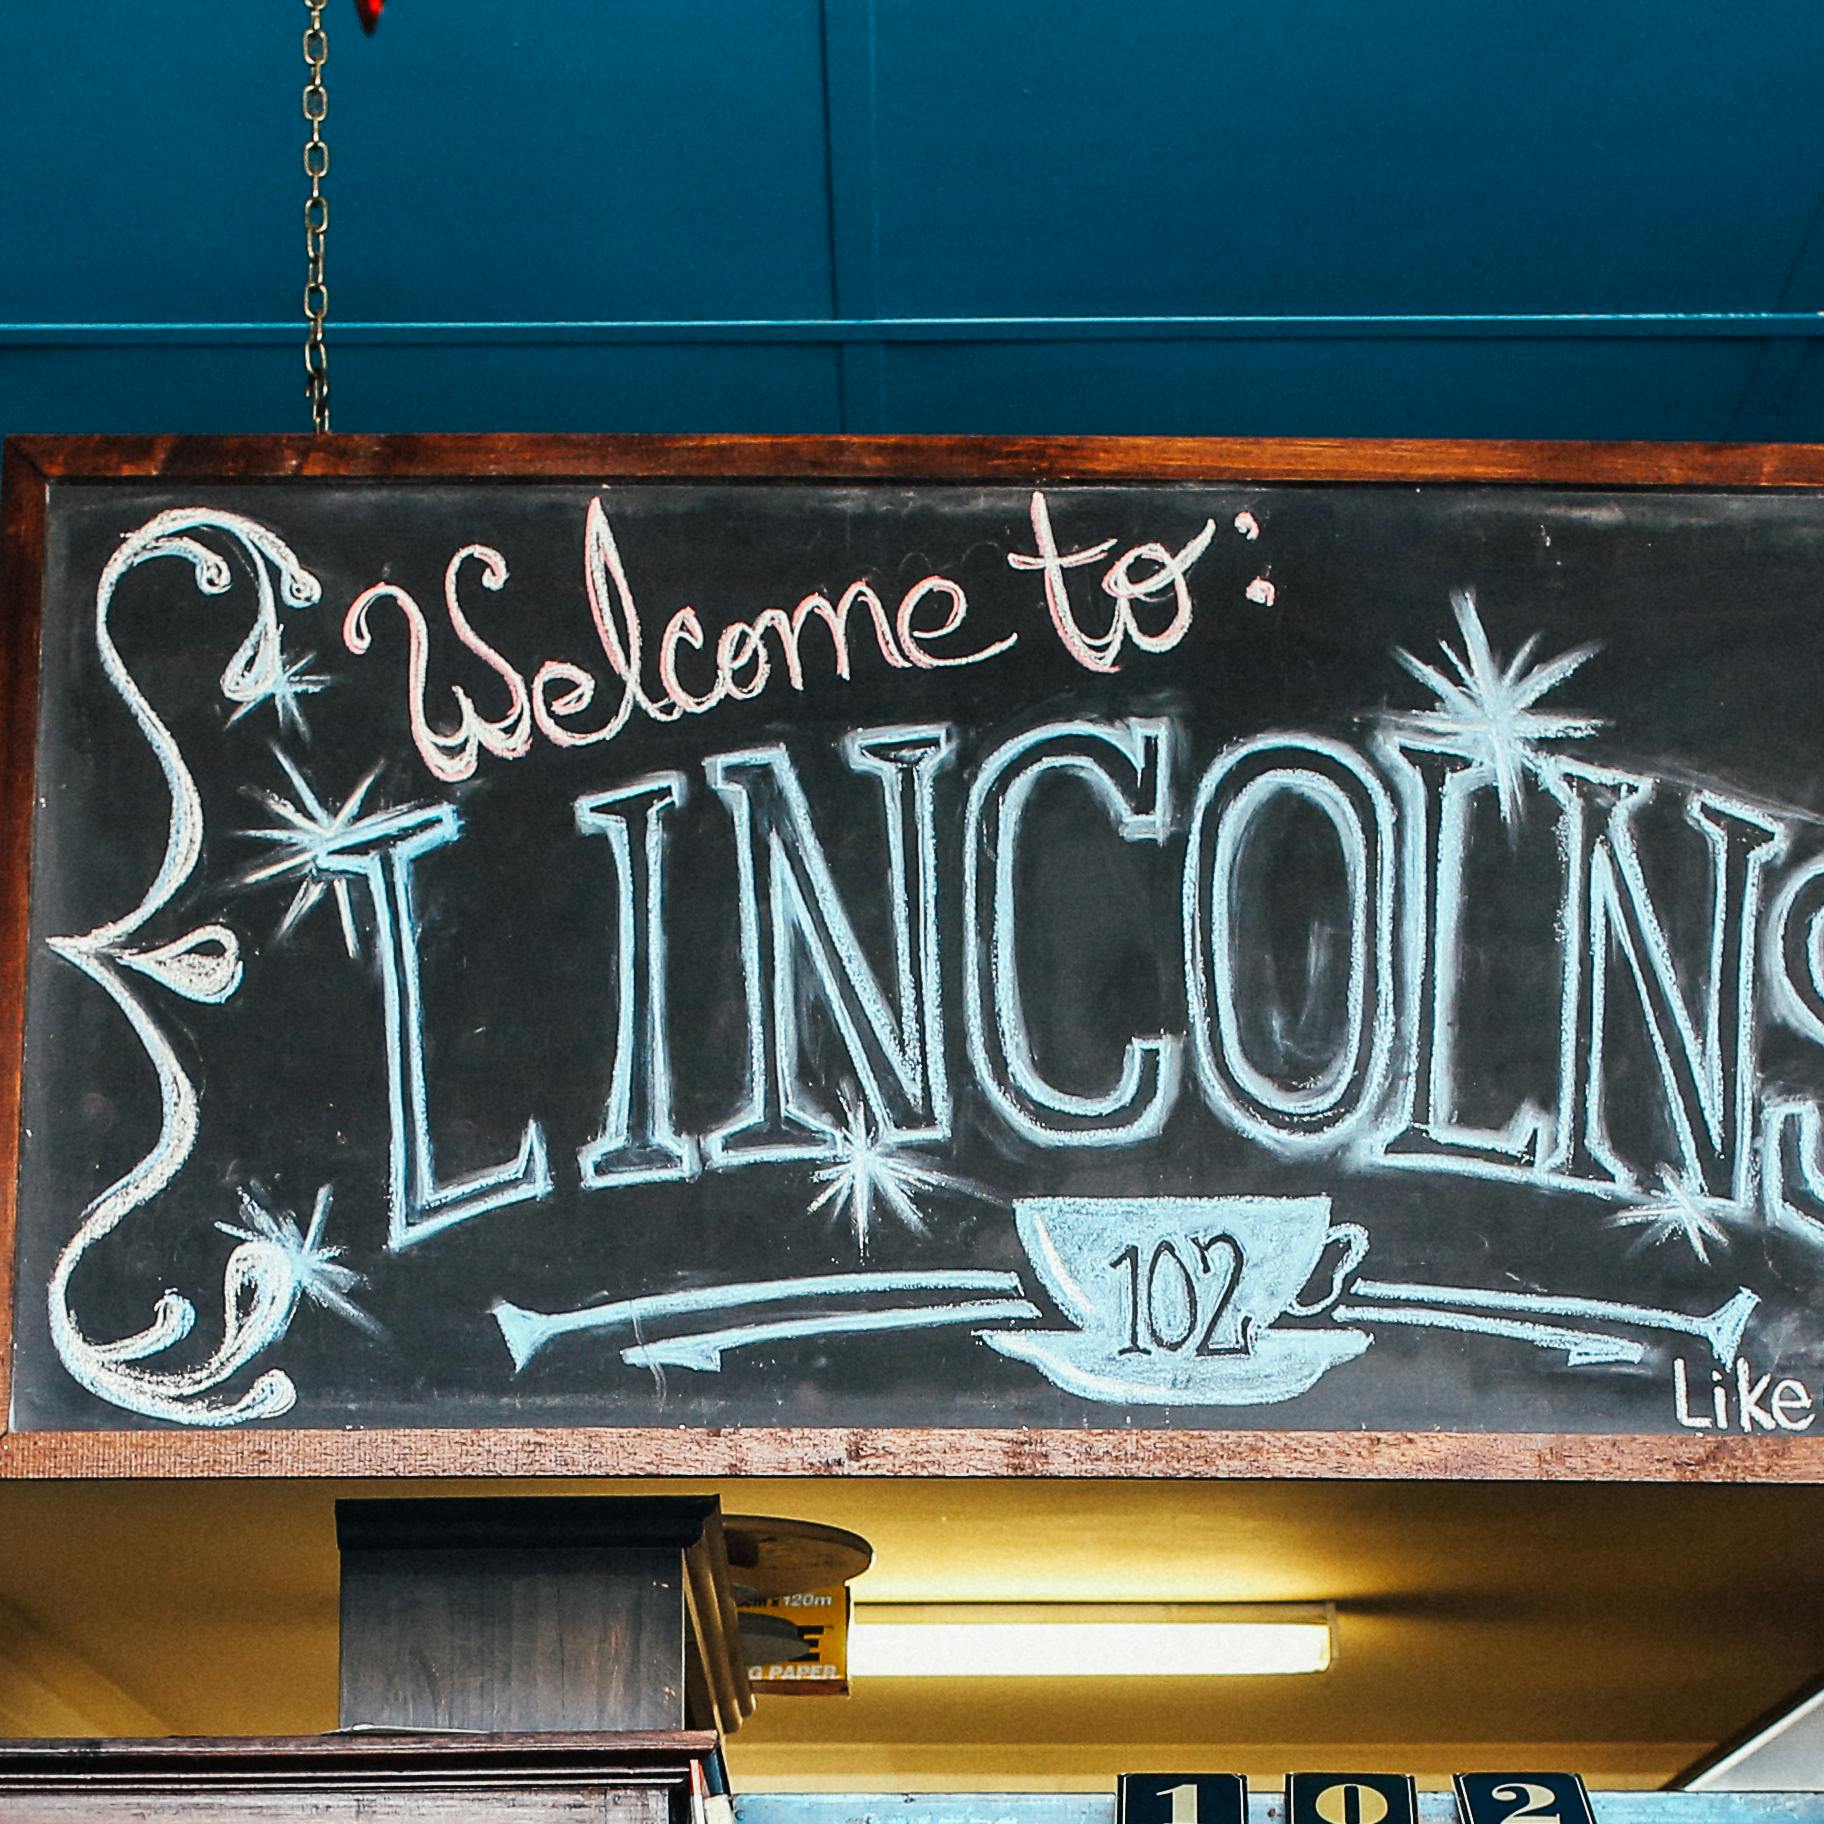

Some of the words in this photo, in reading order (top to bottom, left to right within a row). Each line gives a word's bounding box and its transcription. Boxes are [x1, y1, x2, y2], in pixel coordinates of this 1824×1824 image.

[343, 495, 1018, 783] Welcome
[1007, 489, 1276, 673] to:
[1108, 1233, 1257, 1358] 102
[1673, 1356, 1817, 1434] Like
[768, 1664, 838, 1680] PAPER
